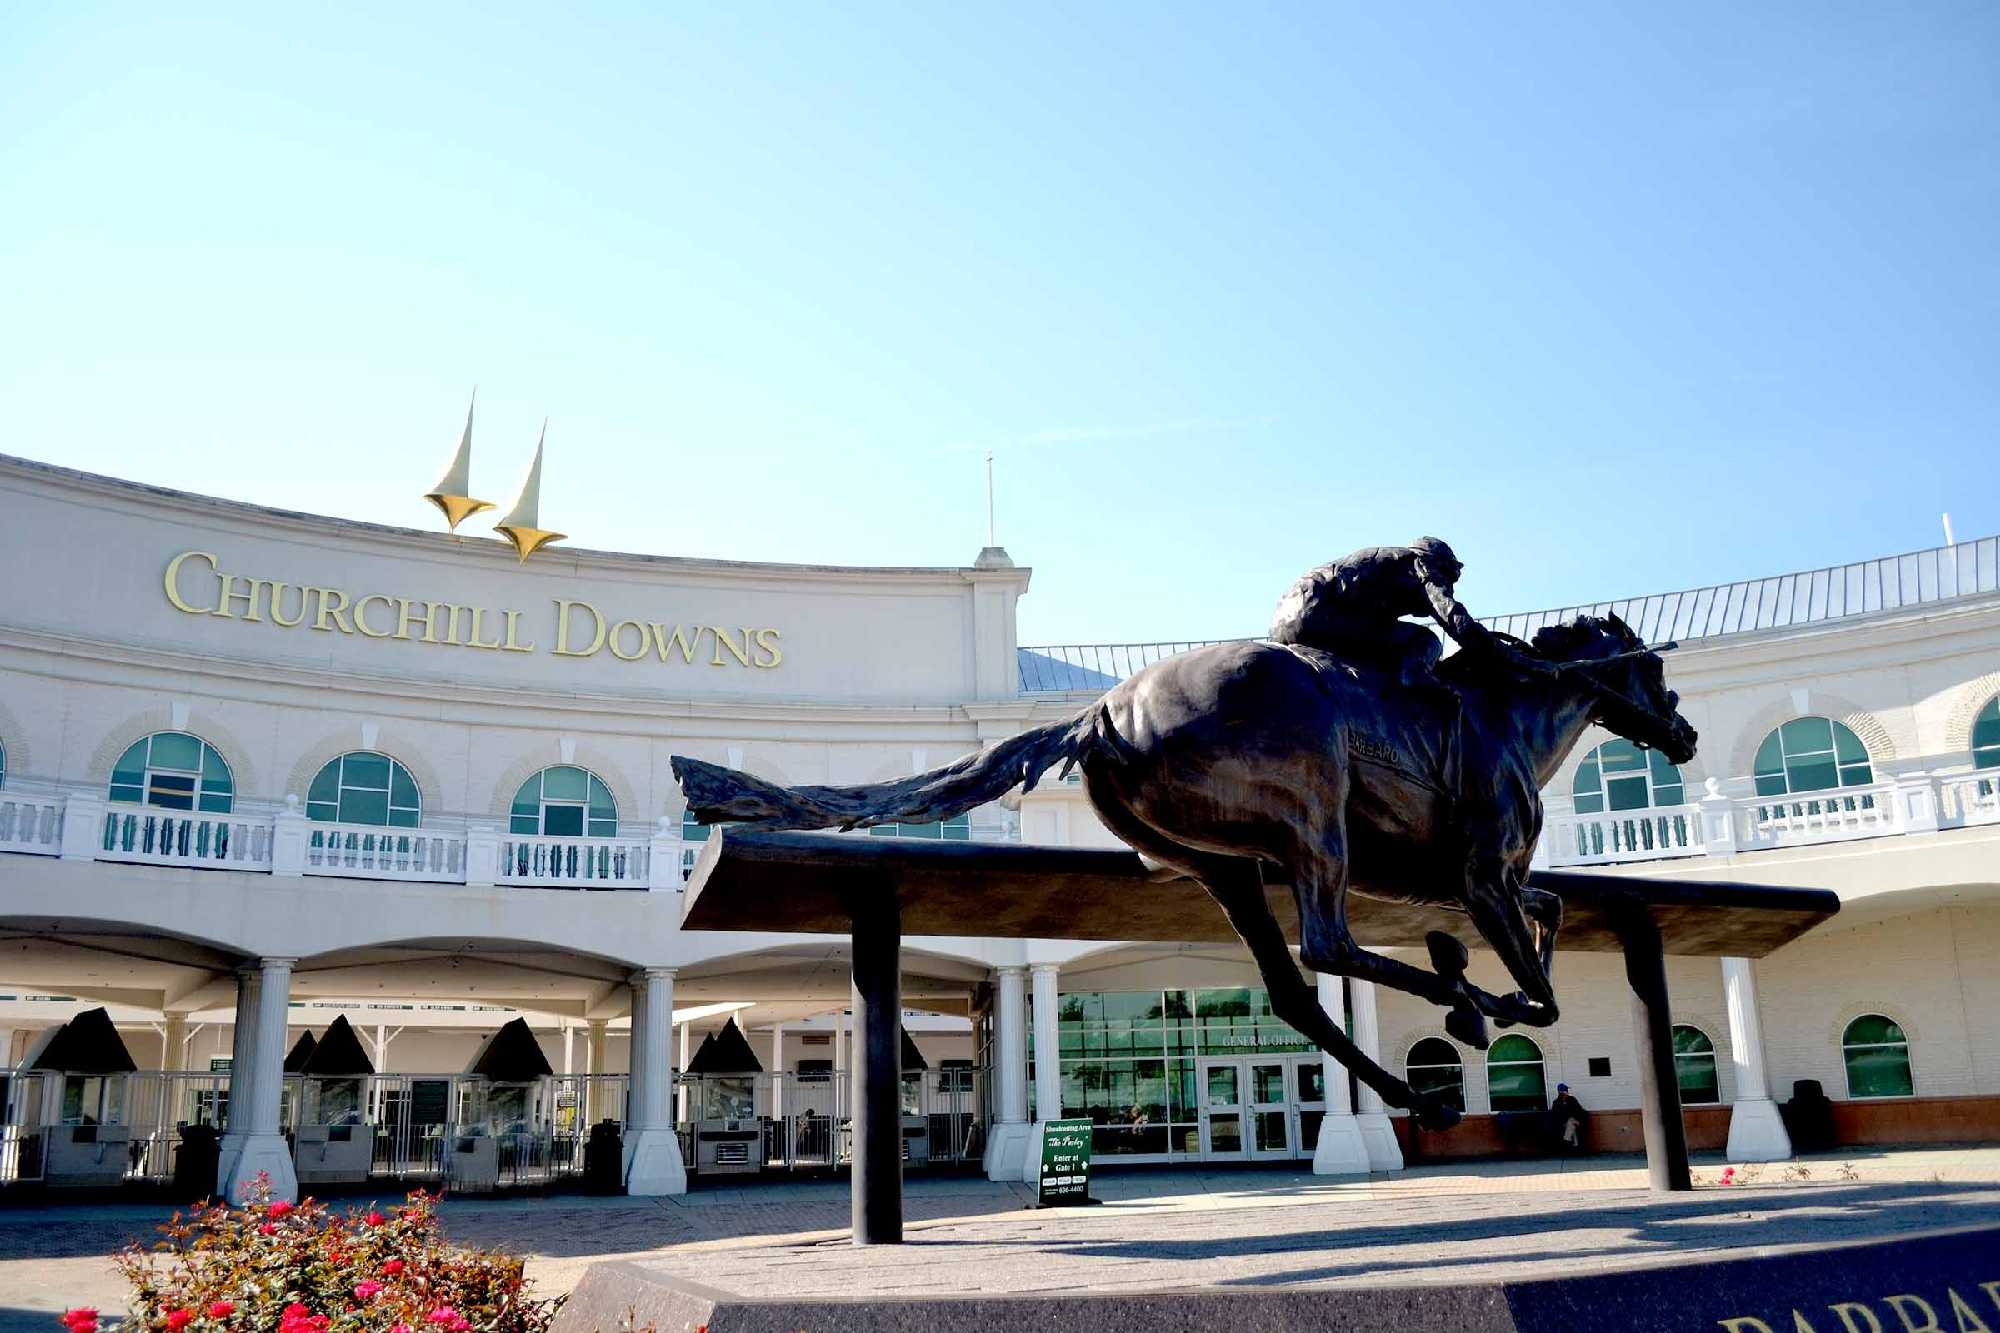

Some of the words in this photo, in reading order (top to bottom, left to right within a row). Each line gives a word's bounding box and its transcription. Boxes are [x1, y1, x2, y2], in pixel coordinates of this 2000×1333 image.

[164, 550, 535, 653] CHURCHILL
[550, 598, 783, 668] DOWNS
[1054, 1154, 1071, 1162] Enter
